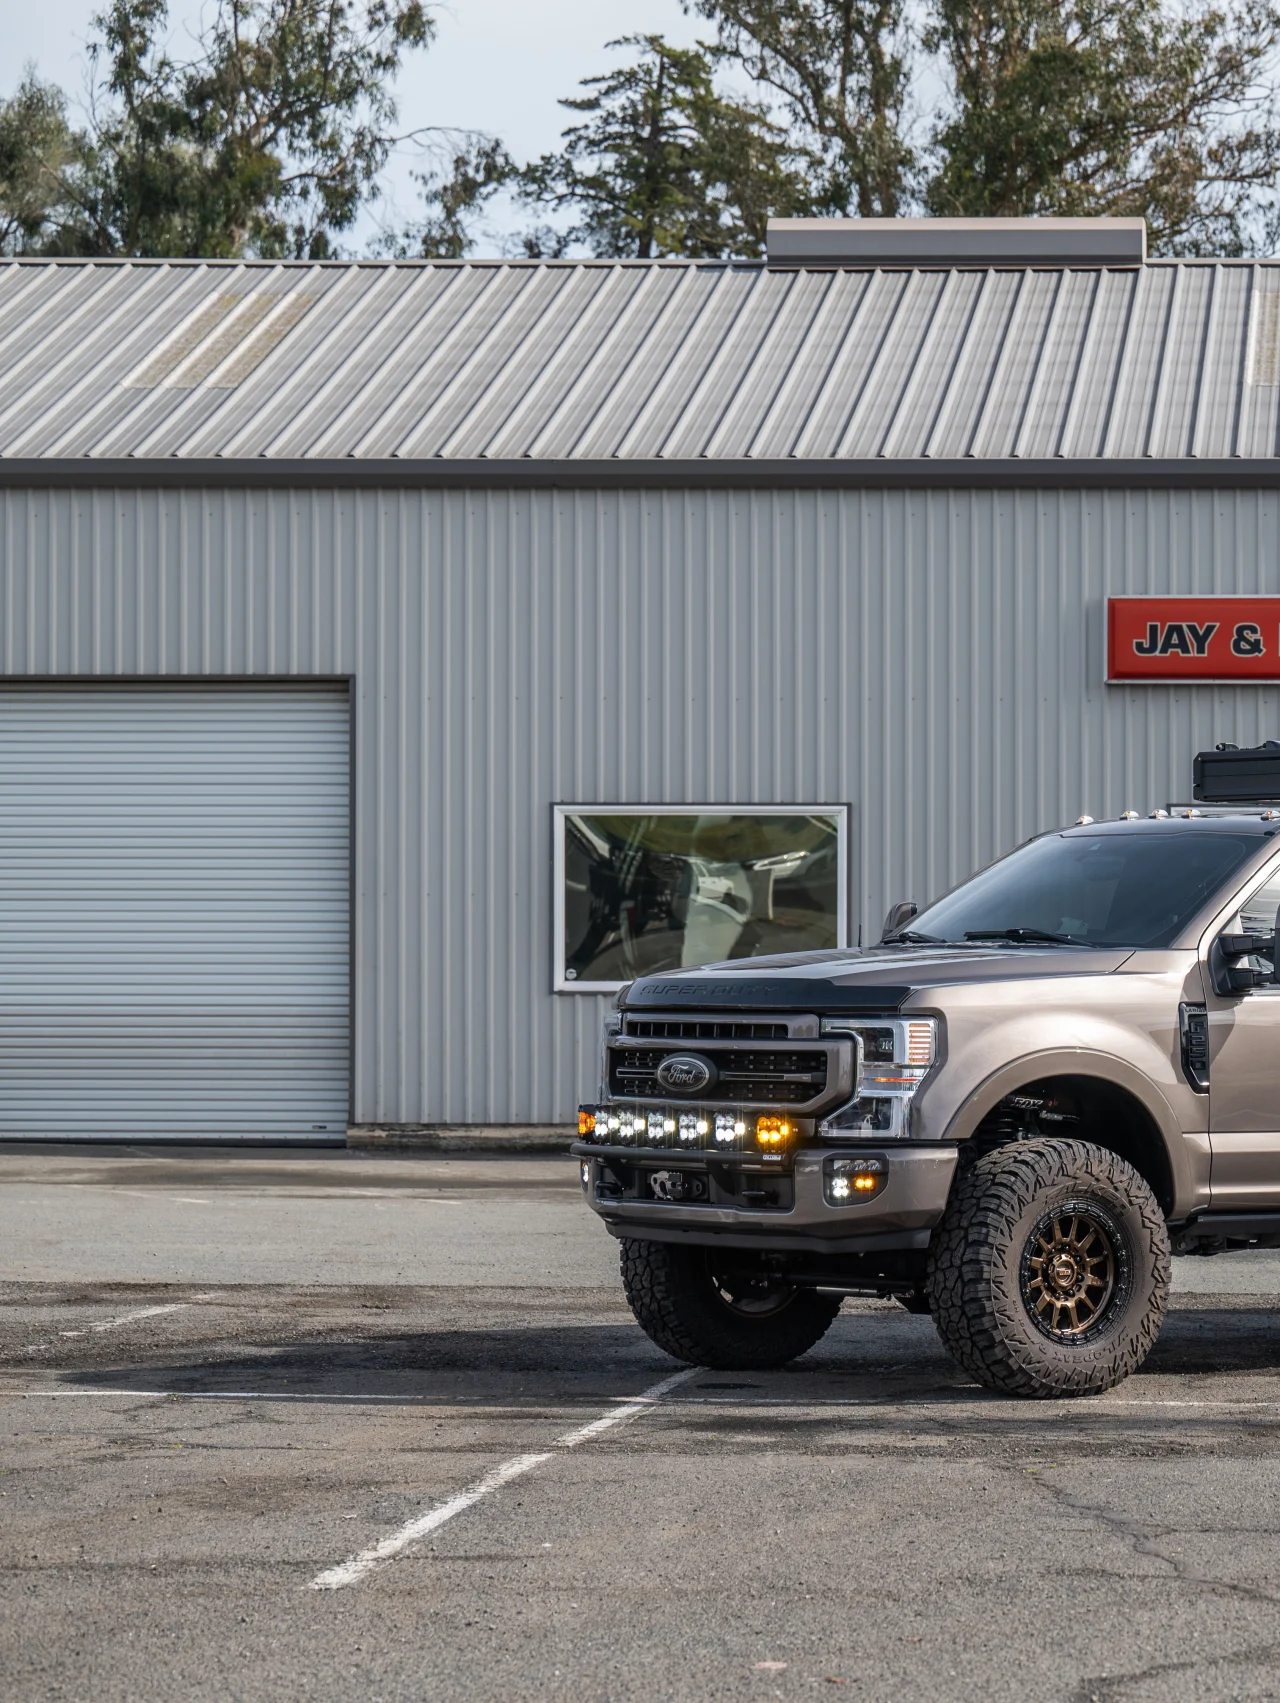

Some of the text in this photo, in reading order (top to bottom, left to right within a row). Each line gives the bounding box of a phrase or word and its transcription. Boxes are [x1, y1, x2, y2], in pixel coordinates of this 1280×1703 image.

[1133, 621, 1220, 657] JAY
[1231, 622, 1266, 657] &
[640, 985, 779, 996] SUPER DUTY
[667, 1064, 696, 1083] Ford
[1045, 1181, 1132, 1219] FALKEN
